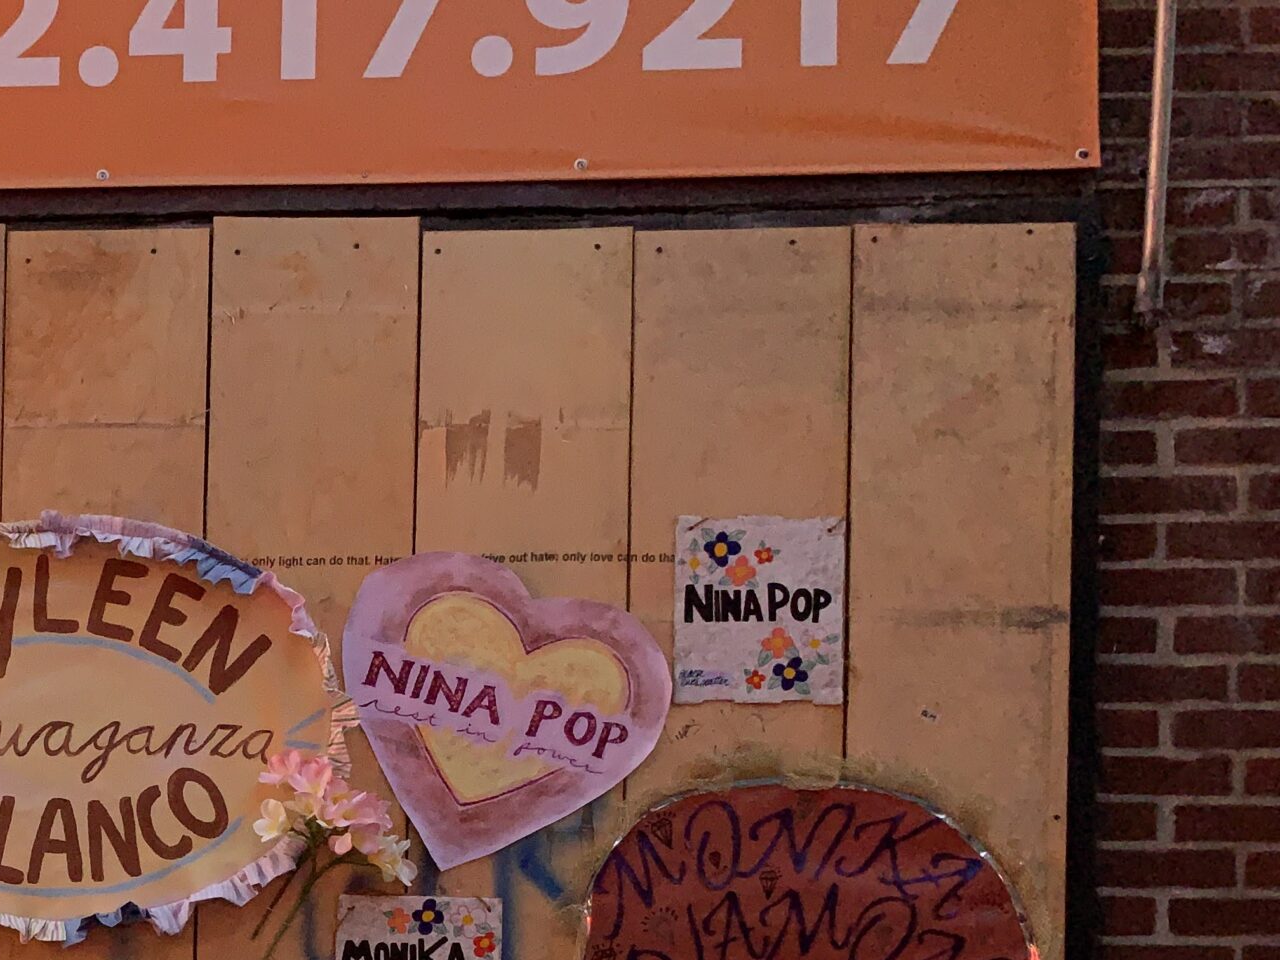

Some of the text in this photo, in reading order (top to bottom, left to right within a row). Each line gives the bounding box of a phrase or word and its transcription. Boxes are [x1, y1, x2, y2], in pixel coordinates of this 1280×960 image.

[251, 556, 276, 569] only
[279, 555, 304, 569] light
[306, 556, 326, 567] can
[329, 555, 344, 566] do
[347, 555, 370, 566] that.
[509, 554, 528, 564] out
[562, 553, 586, 565] only
[590, 552, 614, 562] love
[617, 553, 638, 563] can
[641, 552, 656, 563] do
[658, 552, 676, 563] tha
[683, 582, 833, 624] NINA POP
[361, 650, 629, 759] NINA POP
[358, 698, 608, 775] rest in power
